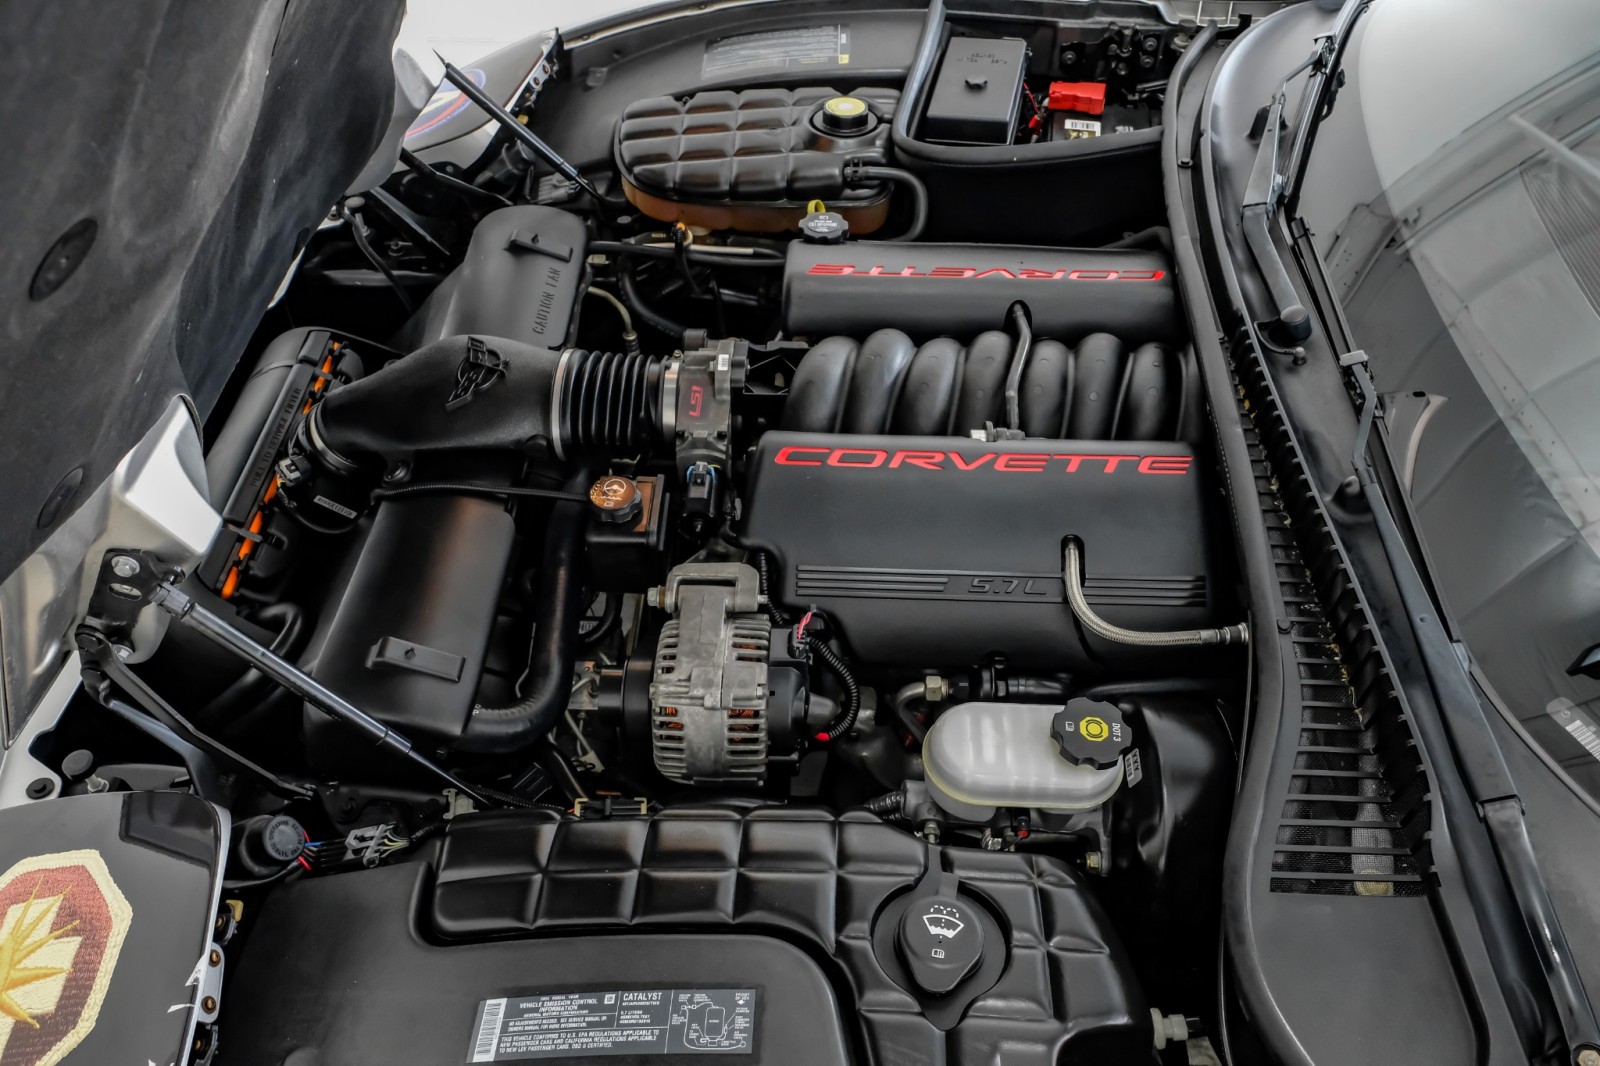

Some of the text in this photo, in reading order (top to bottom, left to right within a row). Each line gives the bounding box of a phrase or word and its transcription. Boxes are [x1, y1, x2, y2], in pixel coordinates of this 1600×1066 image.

[806, 263, 1166, 280] CORVETTE
[688, 385, 704, 417] LS1
[774, 446, 1193, 474] CORVETTE
[968, 578, 1047, 595] 5.7L
[1112, 722, 1121, 736] DOT
[623, 992, 662, 1001] CATALYST
